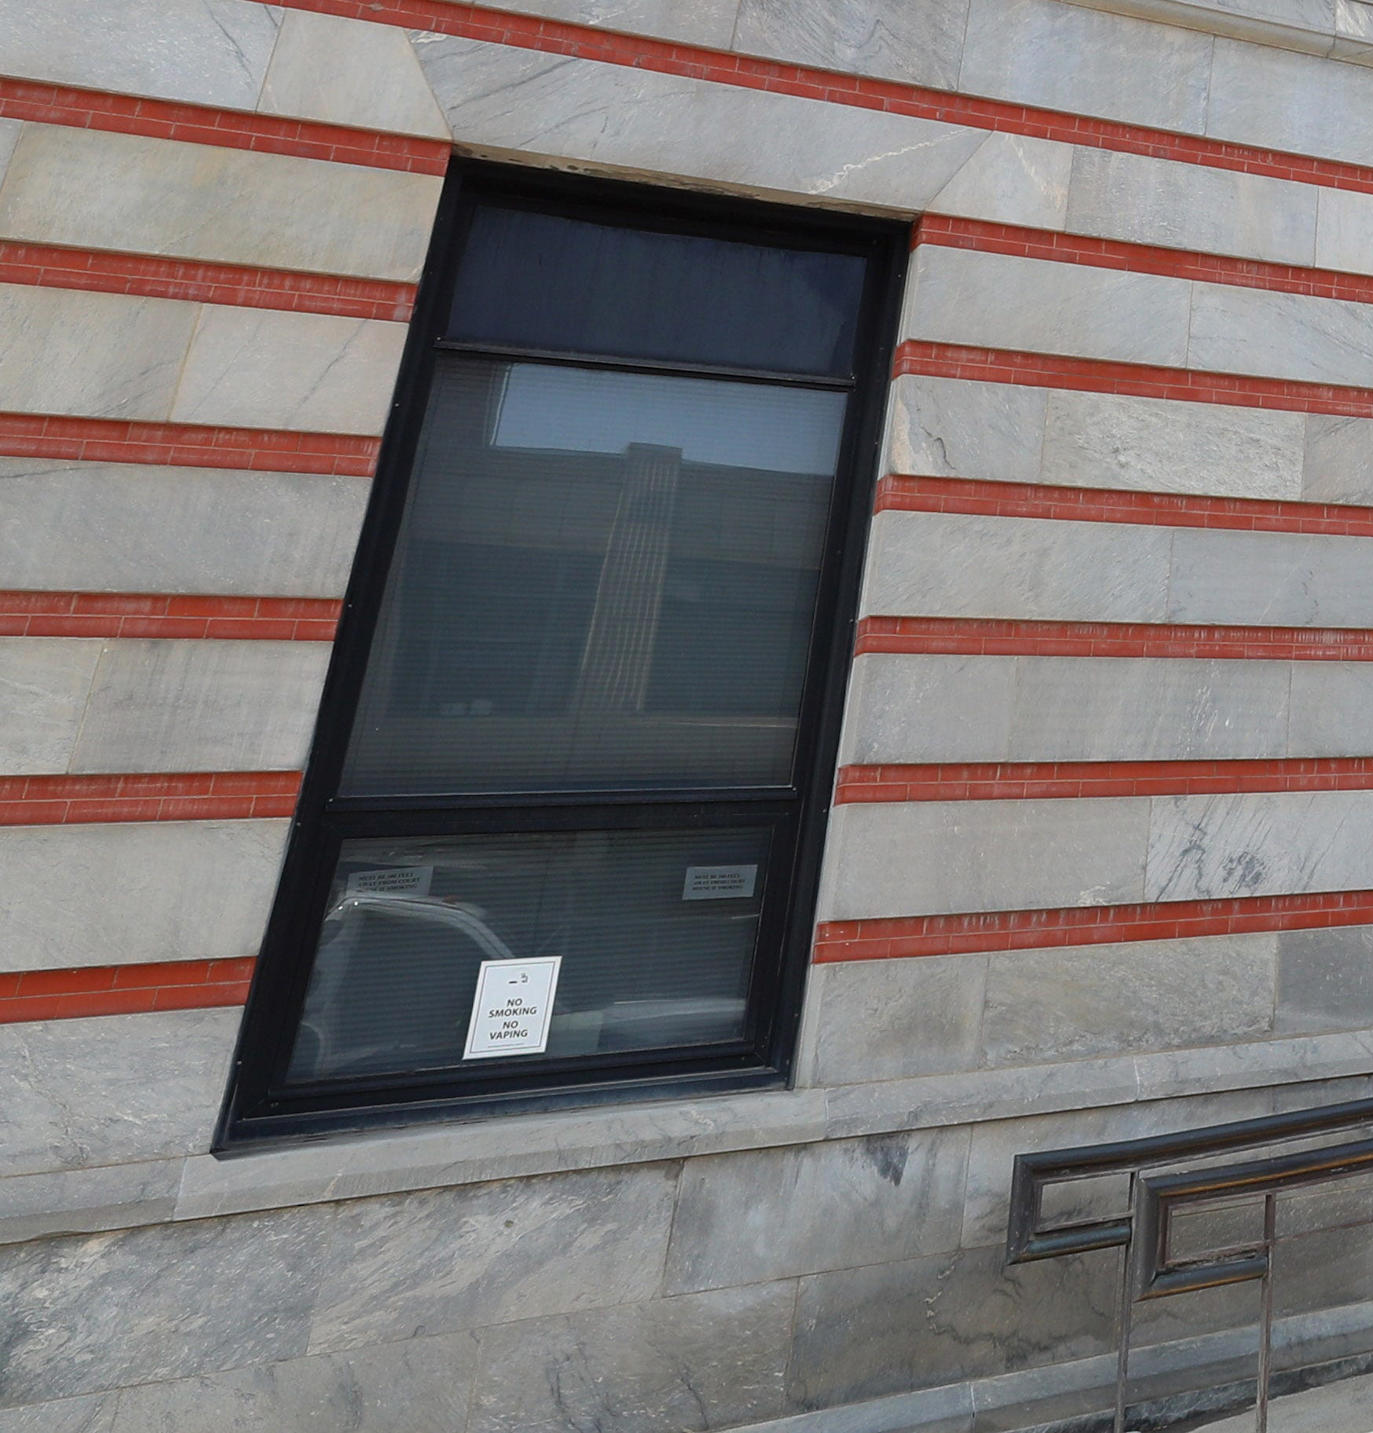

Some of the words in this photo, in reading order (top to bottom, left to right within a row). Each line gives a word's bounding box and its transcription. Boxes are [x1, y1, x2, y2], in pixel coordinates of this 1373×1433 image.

[506, 998, 523, 1007] NO
[488, 1006, 538, 1018] SMOKING
[502, 1020, 519, 1029] NO
[489, 1029, 529, 1040] VAPING
